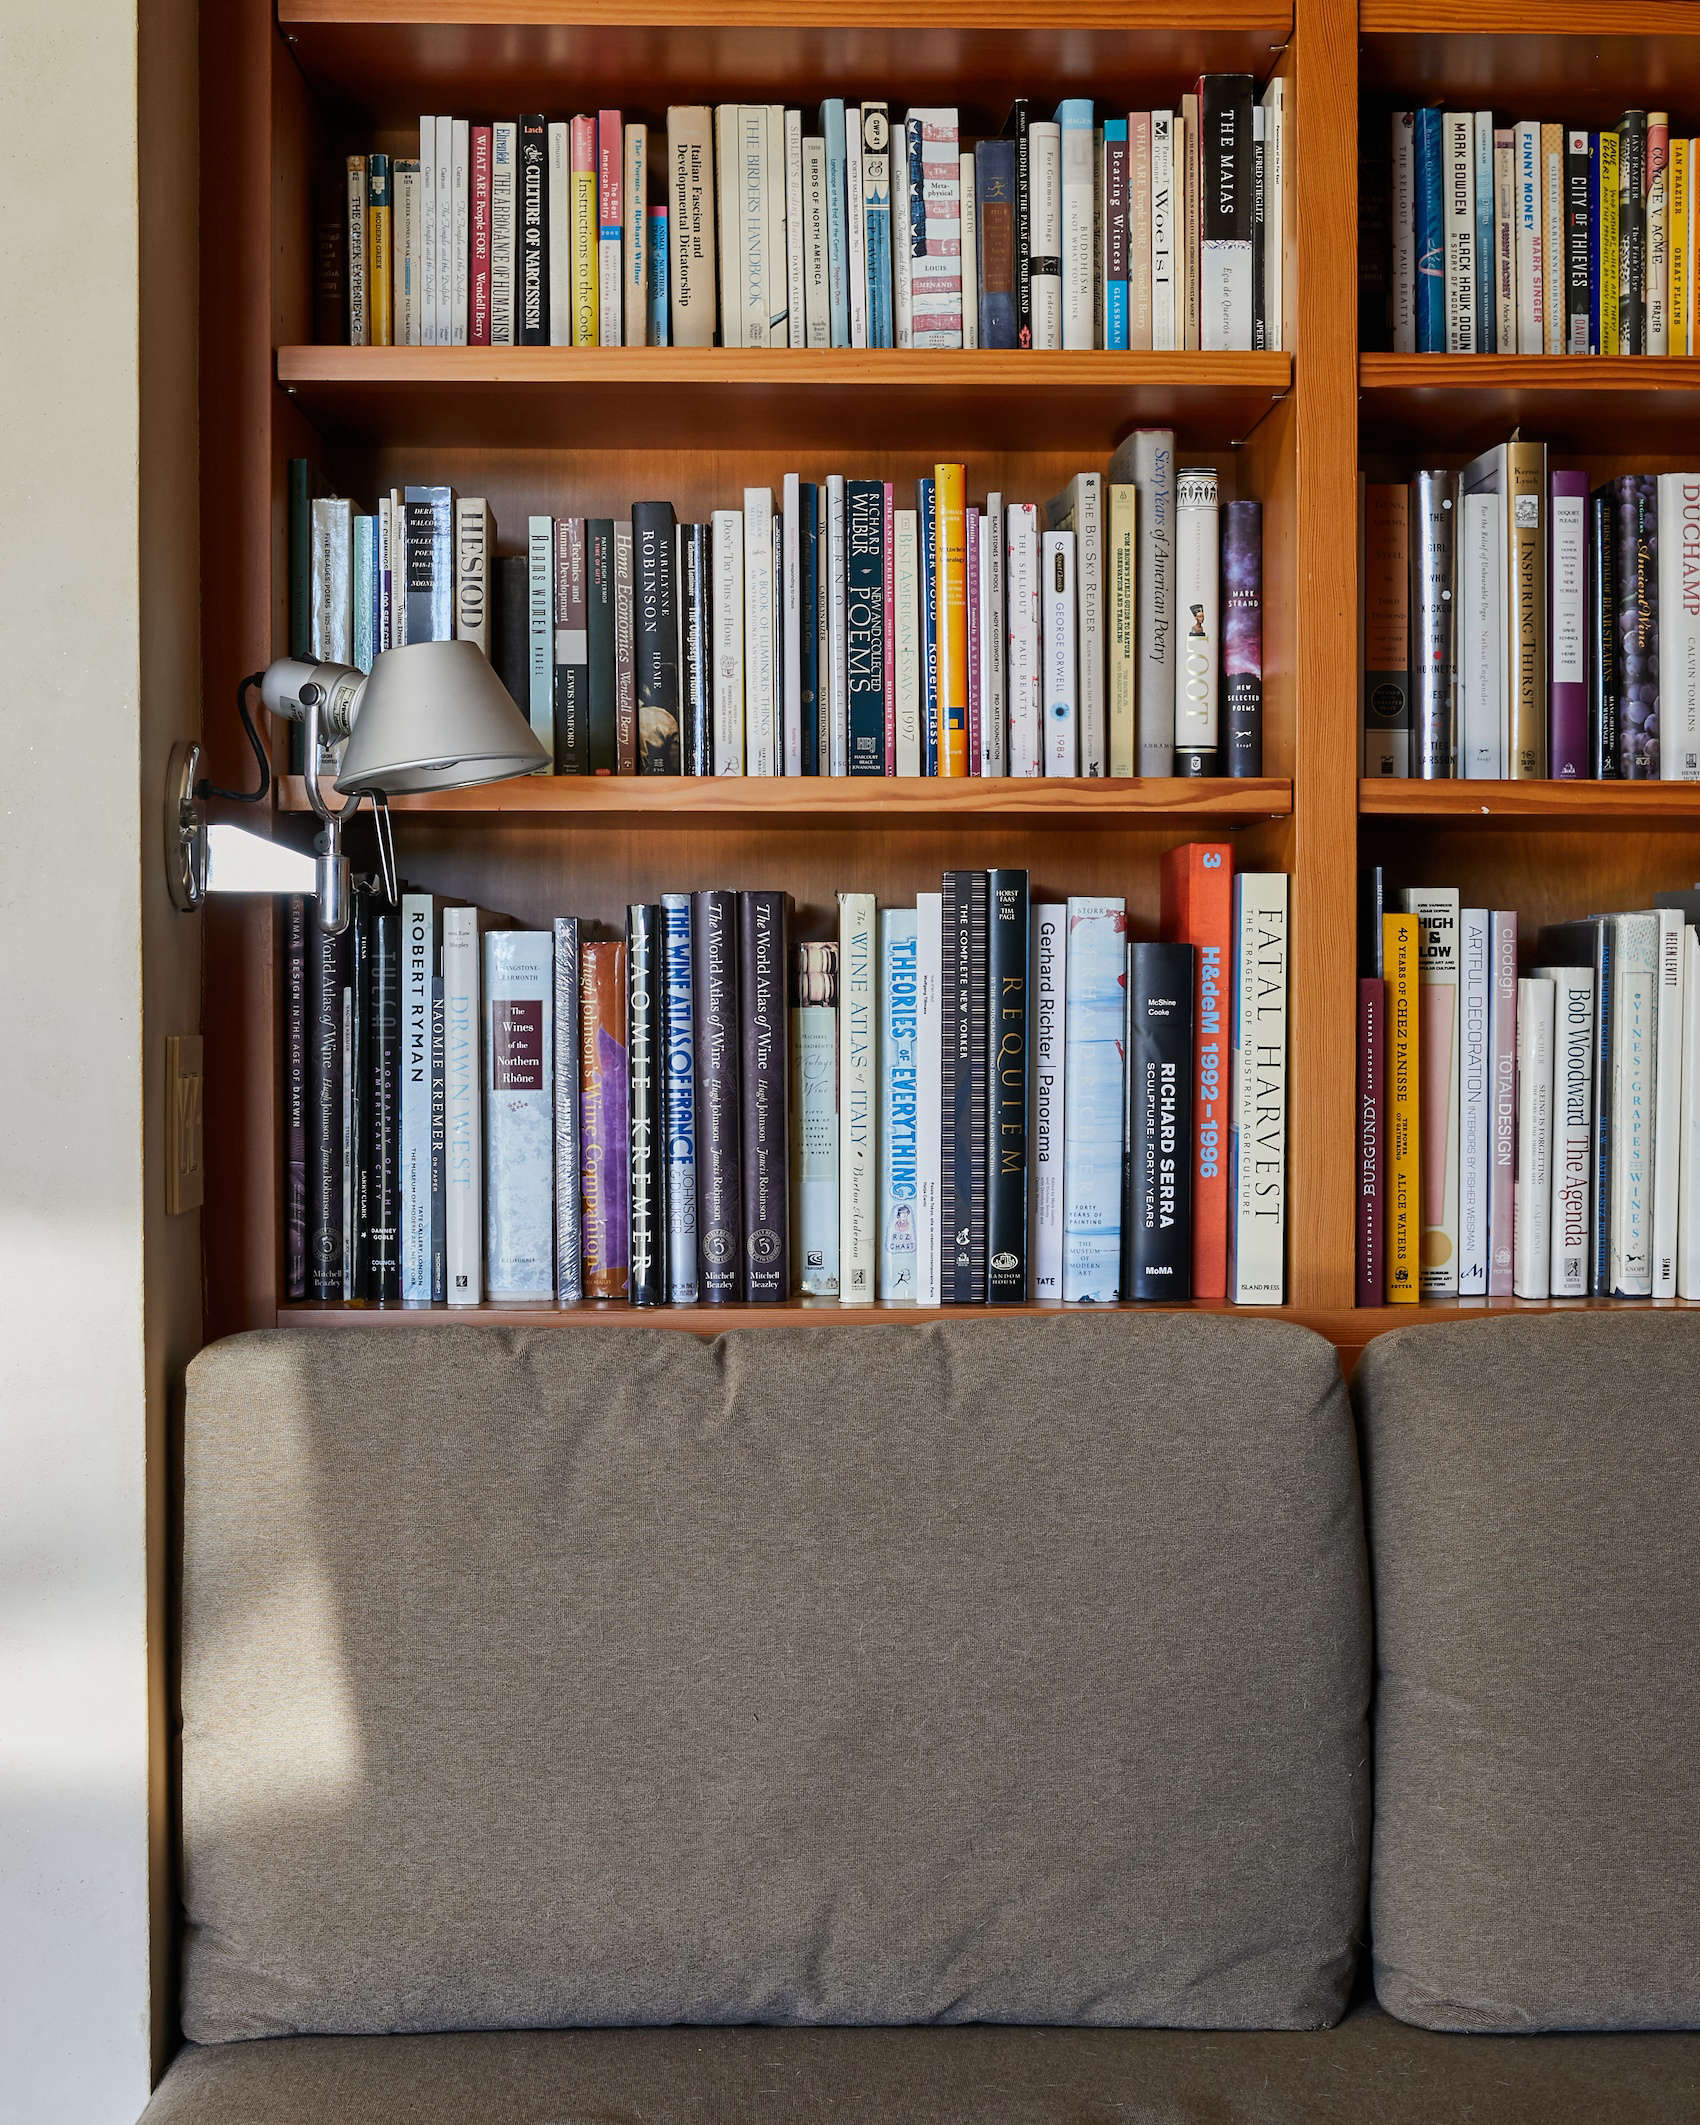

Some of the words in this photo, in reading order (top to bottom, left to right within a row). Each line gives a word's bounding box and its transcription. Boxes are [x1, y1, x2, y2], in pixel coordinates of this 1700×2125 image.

[524, 126, 543, 134] Lasch
[873, 136, 880, 145] 41
[1220, 110, 1234, 147] THE
[1454, 123, 1466, 158] MARK
[476, 135, 486, 172] WHAT
[691, 144, 702, 182] Italian
[1019, 137, 1028, 178] BUDDHA
[1255, 145, 1263, 178] ALFRED
[1524, 133, 1533, 178] FUNNY
[476, 174, 486, 197] ARE
[525, 165, 540, 225] CULTURE
[676, 144, 688, 230] Developmental
[1020, 181, 1027, 192] IN
[1110, 151, 1123, 206] Bearing
[1220, 154, 1234, 214] MAIAS
[1455, 163, 1466, 215] BOWDEN
[1571, 177, 1586, 207] CITY
[1674, 169, 1682, 214] FRAZIER
[474, 201, 486, 230] People
[579, 178, 592, 258] Instructions
[601, 192, 609, 219] Poetry
[692, 187, 702, 232] Fascism
[1020, 194, 1028, 212] THE
[1255, 179, 1263, 223] STIEGLITZ
[1524, 183, 1534, 230] MONEY
[1575, 213, 1586, 226] OF
[476, 232, 486, 259] FOR?
[525, 228, 540, 246] OF
[693, 236, 703, 258] and
[1020, 215, 1028, 240] PALM
[1113, 214, 1123, 272] Witness
[579, 263, 589, 277] to
[1020, 243, 1029, 256] OF
[1460, 233, 1470, 271] BLACK
[1532, 236, 1542, 271] MARK
[1572, 232, 1587, 287] THIEVES
[476, 272, 486, 309] Wendell
[525, 251, 540, 329] NARCISSISM
[678, 234, 691, 307] Dictatorship
[1021, 258, 1029, 284] YOUR
[1223, 267, 1232, 286] Eça
[579, 281, 592, 303] the
[1021, 286, 1029, 314] HAND
[1223, 287, 1231, 298] de
[1460, 277, 1470, 310] HAWK
[1533, 277, 1543, 323] SINGER
[474, 311, 486, 338] Berry
[580, 306, 592, 341] Cook
[1460, 316, 1471, 350] DOWN
[1152, 448, 1169, 488] Sixty
[852, 493, 868, 556] WILBUR
[869, 493, 879, 555] RICHARD
[1154, 490, 1169, 525] Years
[559, 522, 569, 559] Human
[617, 535, 632, 578] Home
[1150, 528, 1169, 544] of
[1682, 484, 1699, 616] DUCHAMP
[461, 512, 483, 628] HESIOD
[571, 542, 582, 582] Technics
[642, 530, 656, 632] ROBINSON
[659, 540, 669, 616] MARILYNNE
[1154, 545, 1169, 616] American
[558, 562, 570, 622] Development
[571, 585, 581, 603] and
[871, 586, 881, 612] NEW
[1521, 541, 1536, 633] INSPIRING
[617, 584, 632, 662] Economics
[850, 586, 870, 692] POEMS
[872, 612, 881, 637] AND
[1055, 602, 1065, 648] GEORGE
[1150, 619, 1169, 664] Poetry
[652, 652, 662, 689] HOME
[871, 637, 881, 692] COLLECTED
[1056, 651, 1065, 693] ORWELL
[1522, 639, 1537, 708] THIRST
[1687, 637, 1696, 679] CALVIN
[566, 670, 575, 699] LEWIS
[620, 671, 632, 712] Wendell
[1185, 636, 1209, 725] LOOT
[566, 700, 575, 747] MUMFORD
[1688, 683, 1696, 732] TOMKINS
[618, 716, 631, 744] Berry
[1056, 734, 1065, 759] 1984
[1203, 853, 1220, 869] 3
[666, 906, 688, 938] THE
[755, 904, 771, 929] The
[855, 910, 866, 926] The
[960, 904, 968, 924] THE
[411, 912, 424, 996] ROBERT
[756, 931, 771, 974] World
[1398, 927, 1408, 943] 40
[666, 943, 690, 988] WINE
[851, 931, 868, 992] WINE
[959, 929, 968, 984] COMPLETE
[1040, 922, 1054, 992] Gerhard
[1257, 909, 1283, 1022] FATAL
[1398, 946, 1406, 979] YEARS
[756, 977, 771, 1012] Atlas
[890, 938, 917, 1039] THEORIES
[959, 990, 968, 1013] NEW
[1202, 946, 1220, 1034] H&deM
[1398, 981, 1406, 995] OF
[1568, 989, 1590, 1025] Bob
[668, 996, 691, 1047] ATLAS
[754, 1015, 771, 1029] of
[850, 1001, 869, 1067] ATLAS
[959, 1017, 968, 1058] YORKER
[1039, 999, 1054, 1059] Richter
[1398, 998, 1407, 1038] CHEZ
[411, 1005, 424, 1082] RYMAN
[756, 1032, 772, 1070] Wine
[898, 1049, 909, 1061] OF
[666, 1050, 693, 1084] OF
[856, 1073, 866, 1083] of
[997, 975, 1023, 1175] REQUIEM
[1397, 1043, 1407, 1102] PANISSE
[1567, 1028, 1590, 1127] Woodward
[851, 1089, 868, 1148] ITALY
[1039, 1075, 1054, 1163] Panorama
[1146, 1062, 1155, 1139] SCULPTURE:
[1160, 1063, 1175, 1153] RICHARD
[669, 1089, 694, 1164] FRANCE
[890, 1067, 917, 1200] EVERYTHING
[1254, 1045, 1282, 1224] HARVEST
[1362, 1095, 1376, 1196] BURGUNDY
[1146, 1144, 1155, 1183] FORTY
[1566, 1135, 1589, 1172] The
[1146, 1187, 1155, 1228] YEARS
[1160, 1158, 1175, 1228] SERRA
[1397, 1174, 1407, 1207] ALICE
[1560, 1176, 1587, 1247] Agenda
[1397, 1210, 1406, 1259] WATERS
[1036, 1277, 1055, 1286] TATE
[1145, 1266, 1173, 1275] MoMA
